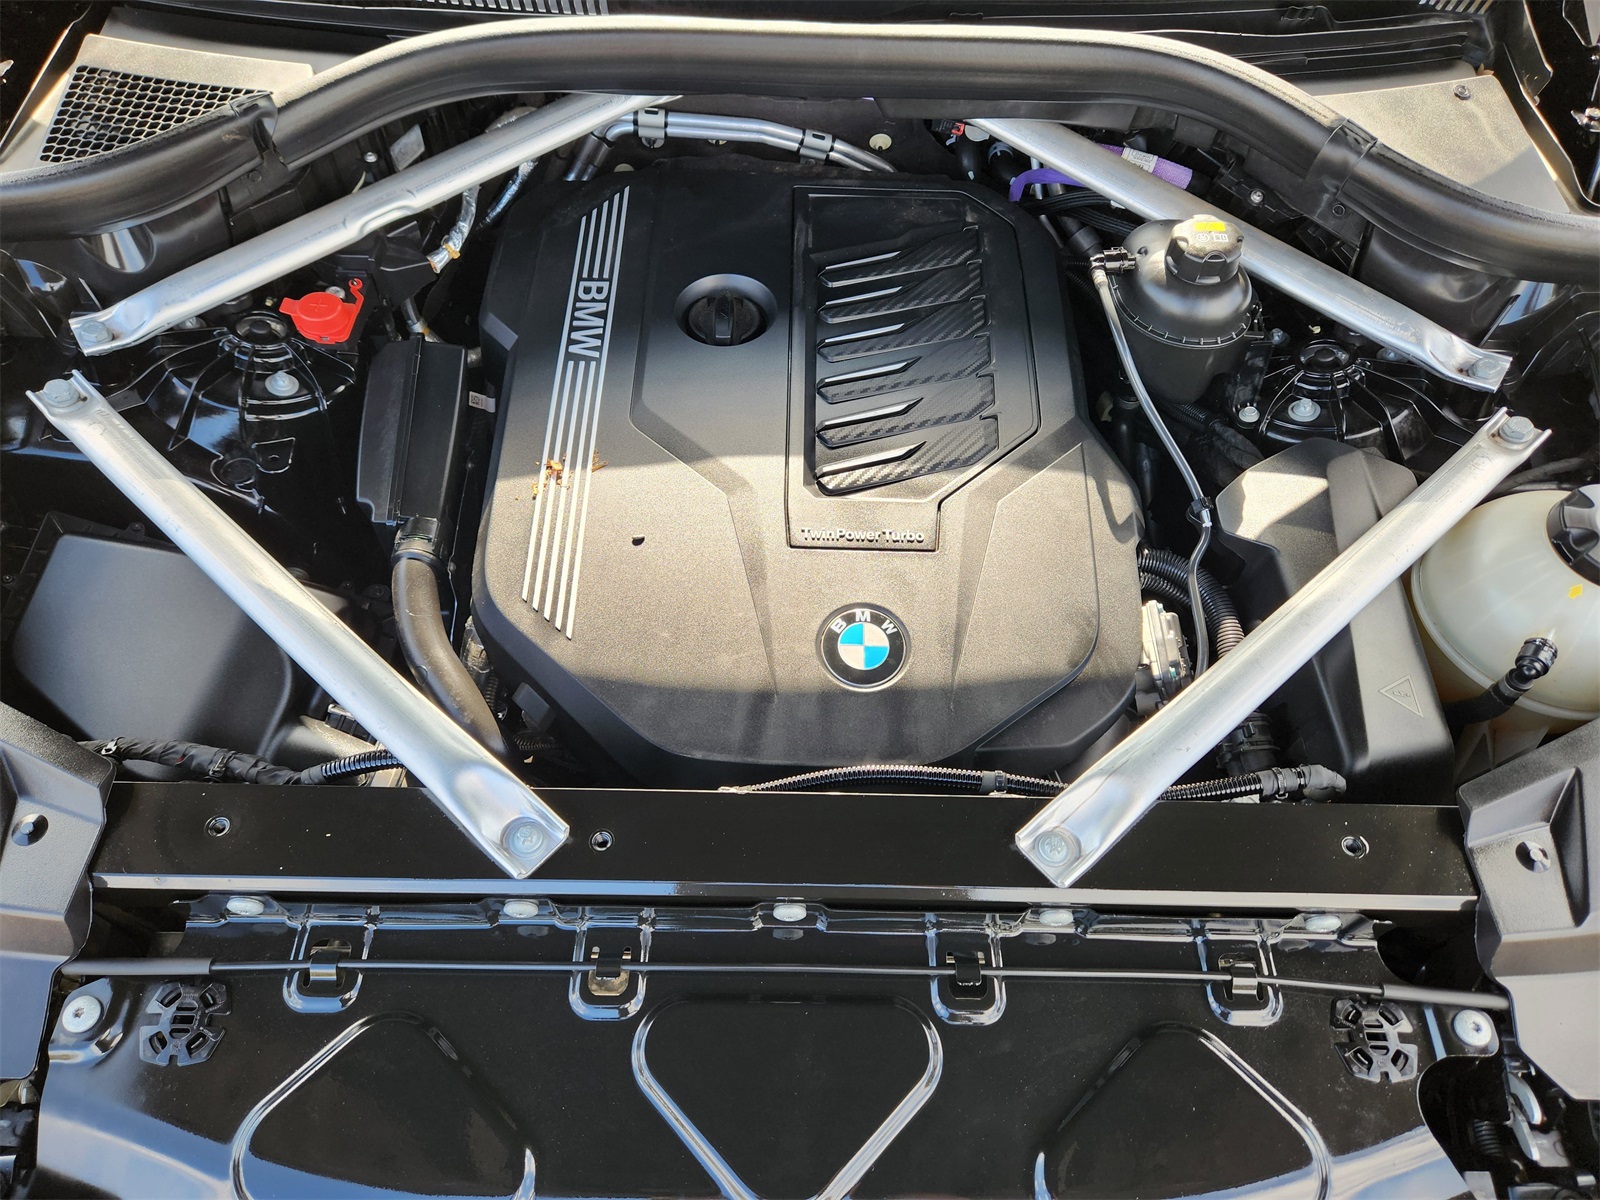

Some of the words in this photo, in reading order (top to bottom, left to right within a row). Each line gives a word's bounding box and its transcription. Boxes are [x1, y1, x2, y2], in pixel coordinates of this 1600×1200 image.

[568, 281, 610, 358] BMW
[882, 529, 925, 543] Turbo
[830, 610, 898, 635] BMW
